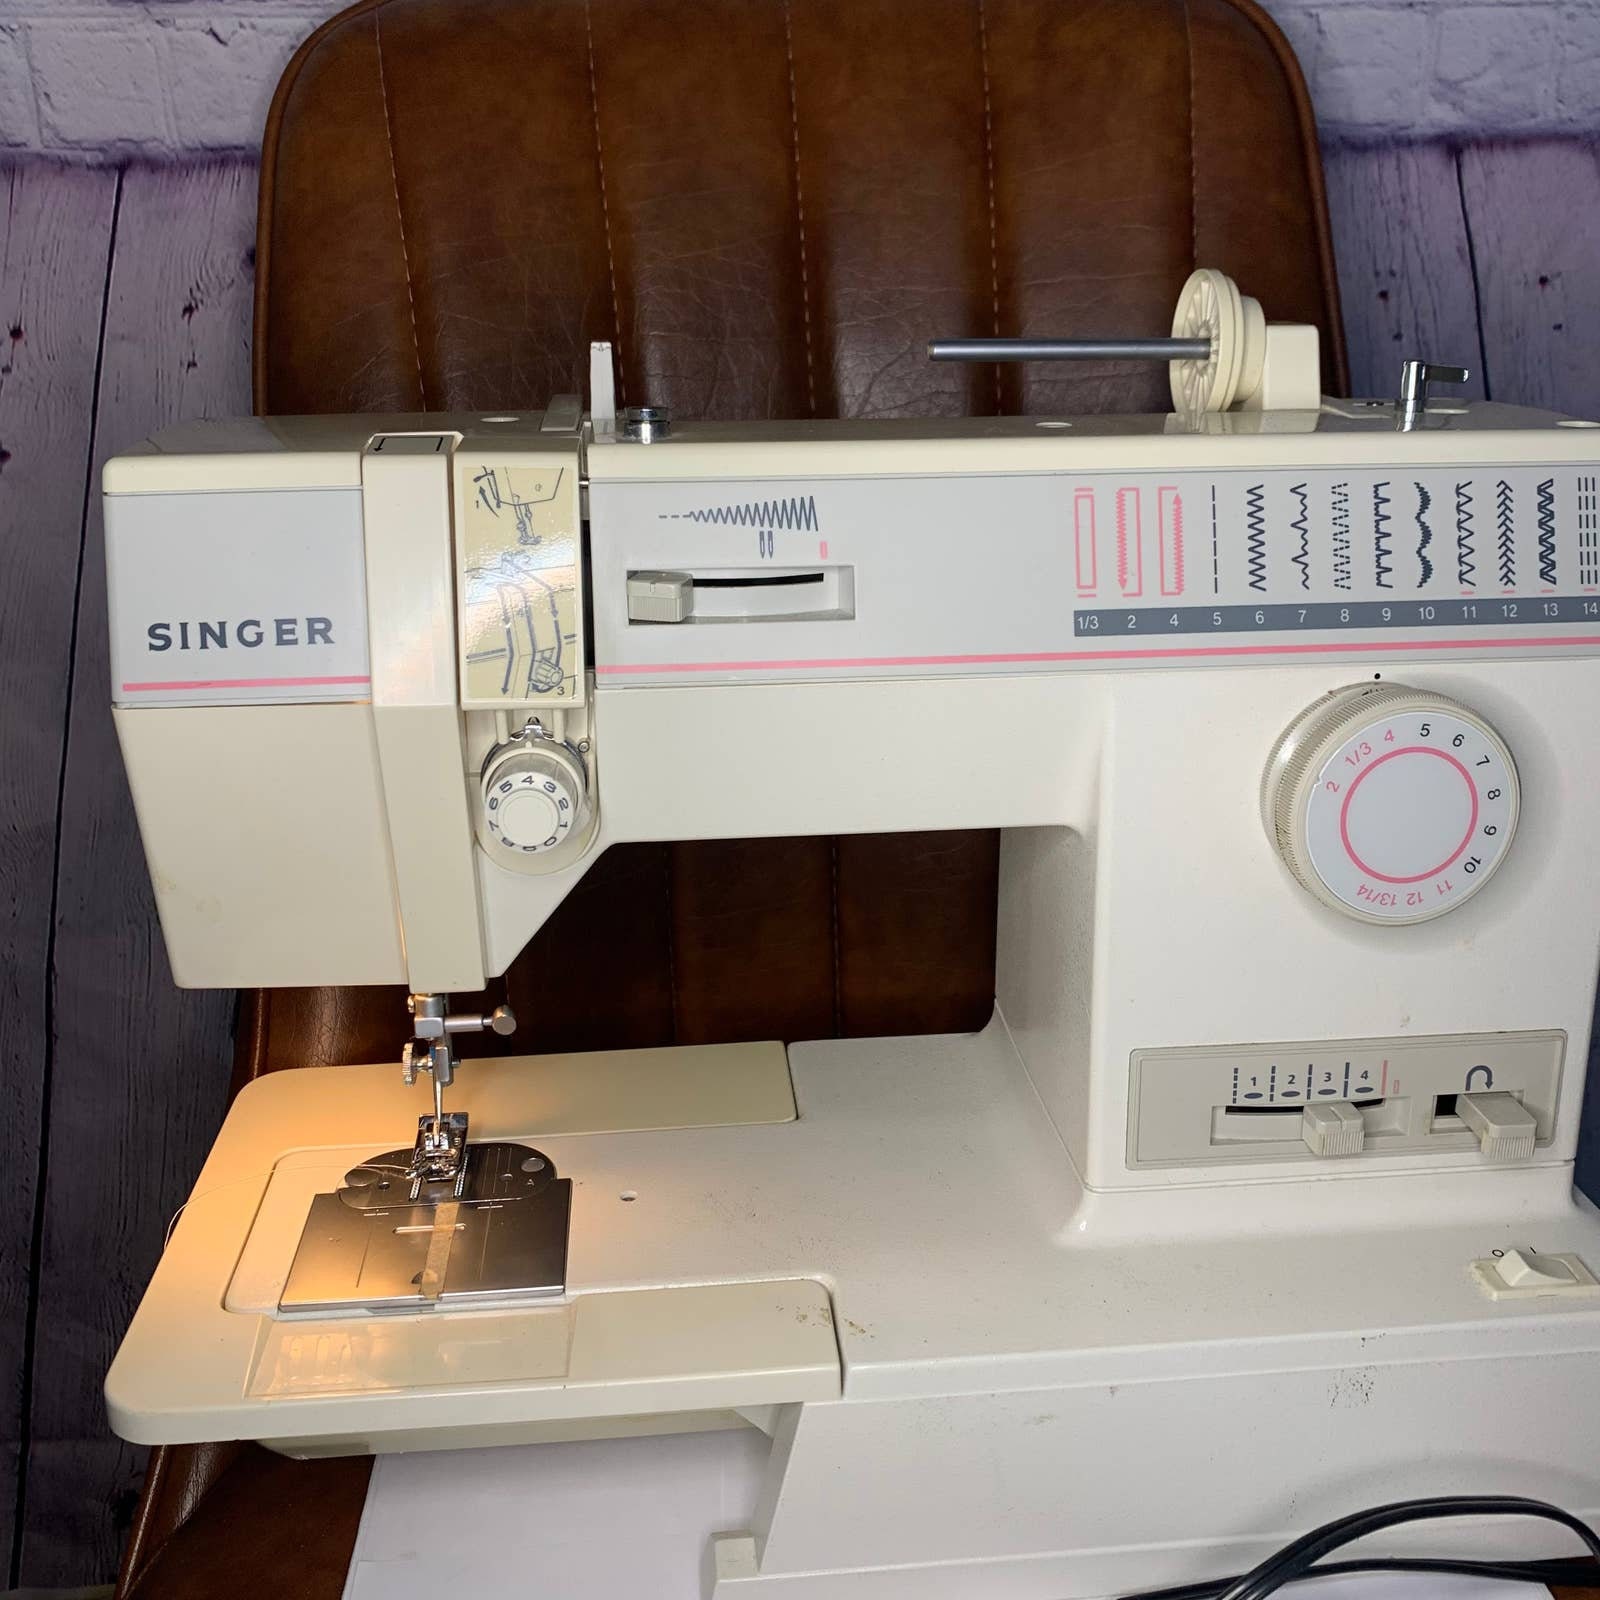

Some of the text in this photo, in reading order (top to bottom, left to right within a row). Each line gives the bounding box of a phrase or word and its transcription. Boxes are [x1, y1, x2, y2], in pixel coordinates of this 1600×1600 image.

[1077, 602, 1598, 630] 1/3 2 4 5 6 7 8 9 10 11 12 13 14
[148, 617, 335, 652] SINGER
[556, 686, 565, 696] 3
[1384, 729, 1395, 742] 4
[1419, 723, 1431, 738] 5
[1452, 733, 1465, 748] 6
[1344, 742, 1372, 767] 1/3
[1475, 755, 1490, 768] 7
[499, 781, 513, 794] 5
[521, 775, 534, 786] 4
[543, 781, 557, 794] 3
[1326, 780, 1340, 793] 2
[1487, 788, 1501, 801] 8
[488, 797, 498, 811] 6
[558, 797, 569, 811] 2
[488, 819, 499, 832] 7
[1483, 824, 1497, 836] 9
[1463, 855, 1481, 874] 10
[1356, 882, 1397, 907] 13/14
[1406, 890, 1424, 906] 12
[1250, 1070, 1369, 1087] 1 2 3 4
